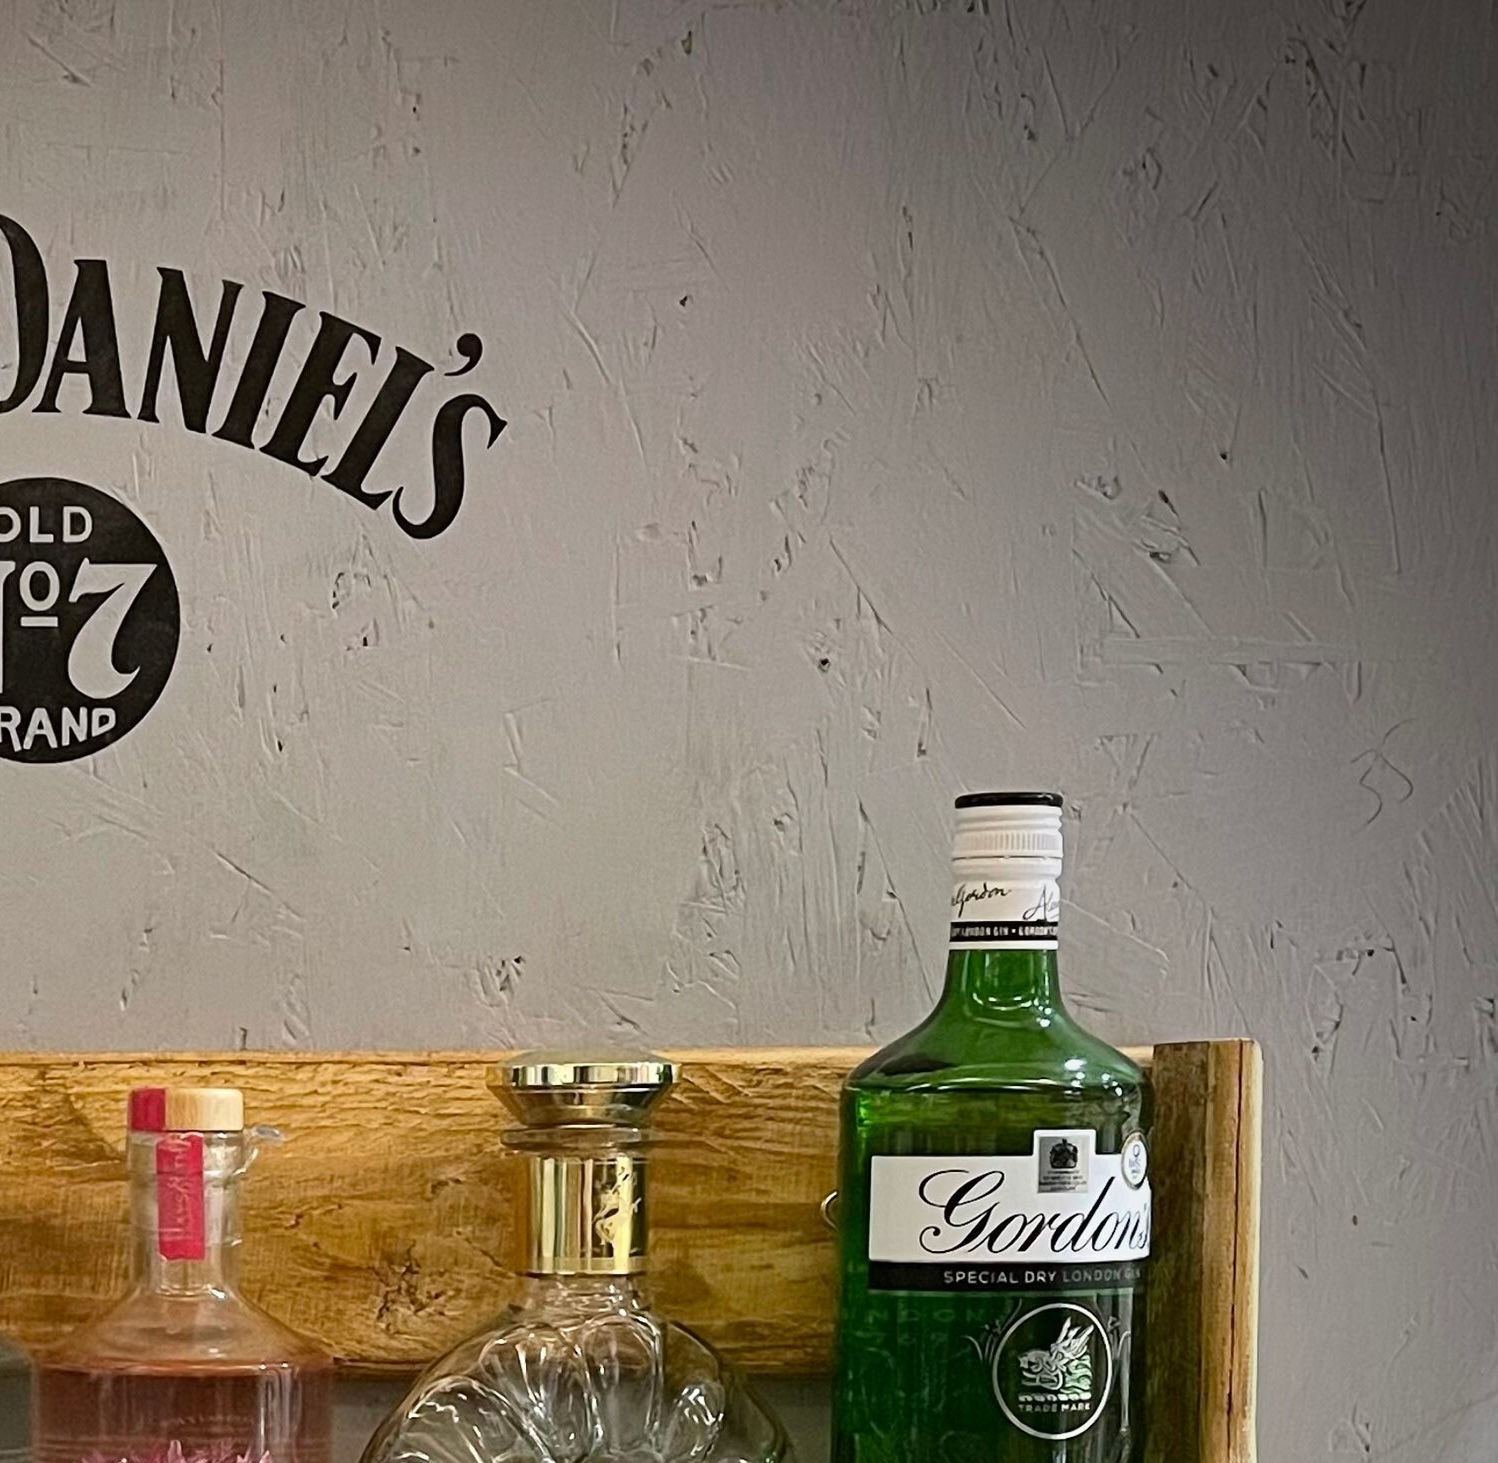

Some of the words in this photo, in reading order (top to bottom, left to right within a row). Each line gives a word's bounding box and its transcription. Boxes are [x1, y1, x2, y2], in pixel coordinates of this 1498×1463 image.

[918, 1169, 1151, 1254] Gordon's
[943, 1270, 1019, 1284] SPECIAL
[1025, 1270, 1057, 1284] DRY
[1062, 1268, 1120, 1283] LONDON
[1018, 1403, 1058, 1413] TRADE
